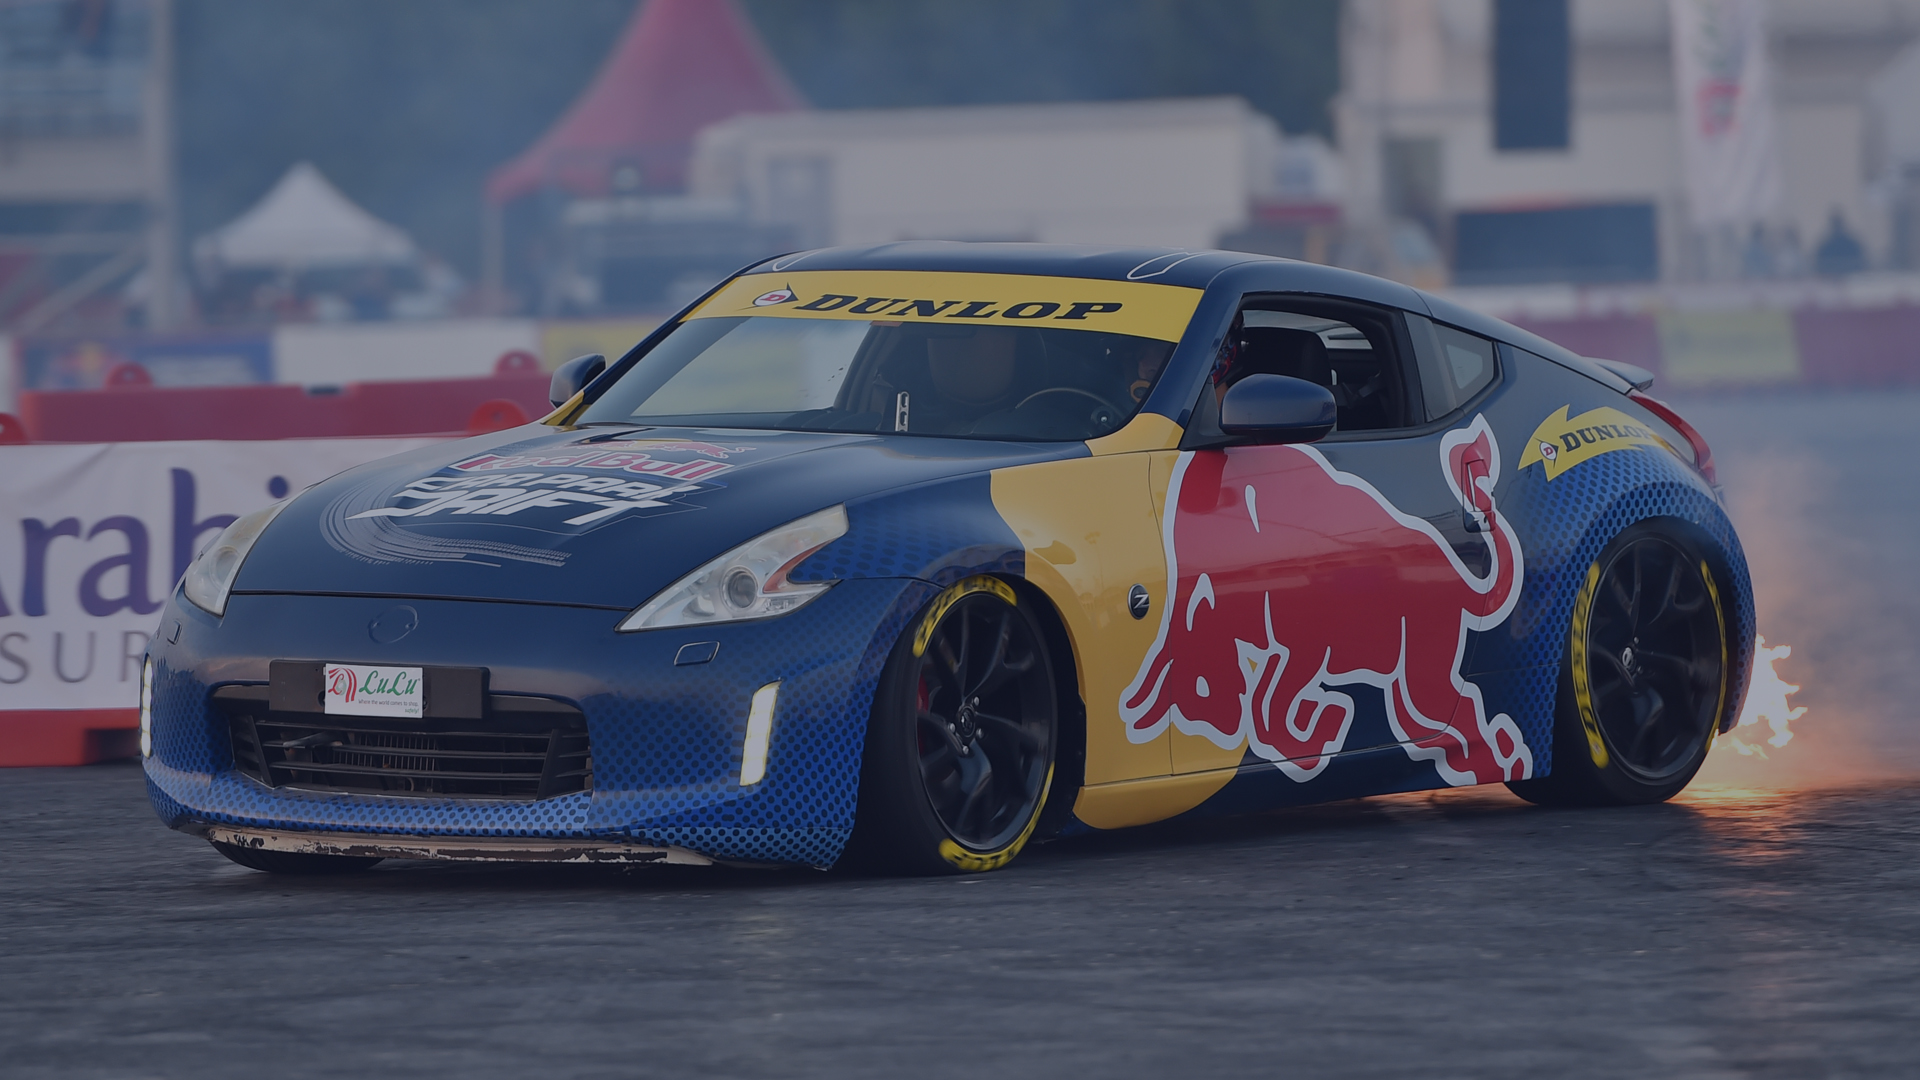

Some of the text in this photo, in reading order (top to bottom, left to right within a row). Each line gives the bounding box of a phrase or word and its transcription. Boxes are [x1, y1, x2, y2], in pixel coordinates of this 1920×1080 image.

[795, 294, 1123, 320] DUNLOP
[450, 451, 735, 480] Red Bull
[404, 473, 702, 500] CAR PARK
[345, 488, 670, 526] DRIFT
[1133, 594, 1149, 608] Z
[358, 670, 419, 696] LuLu
